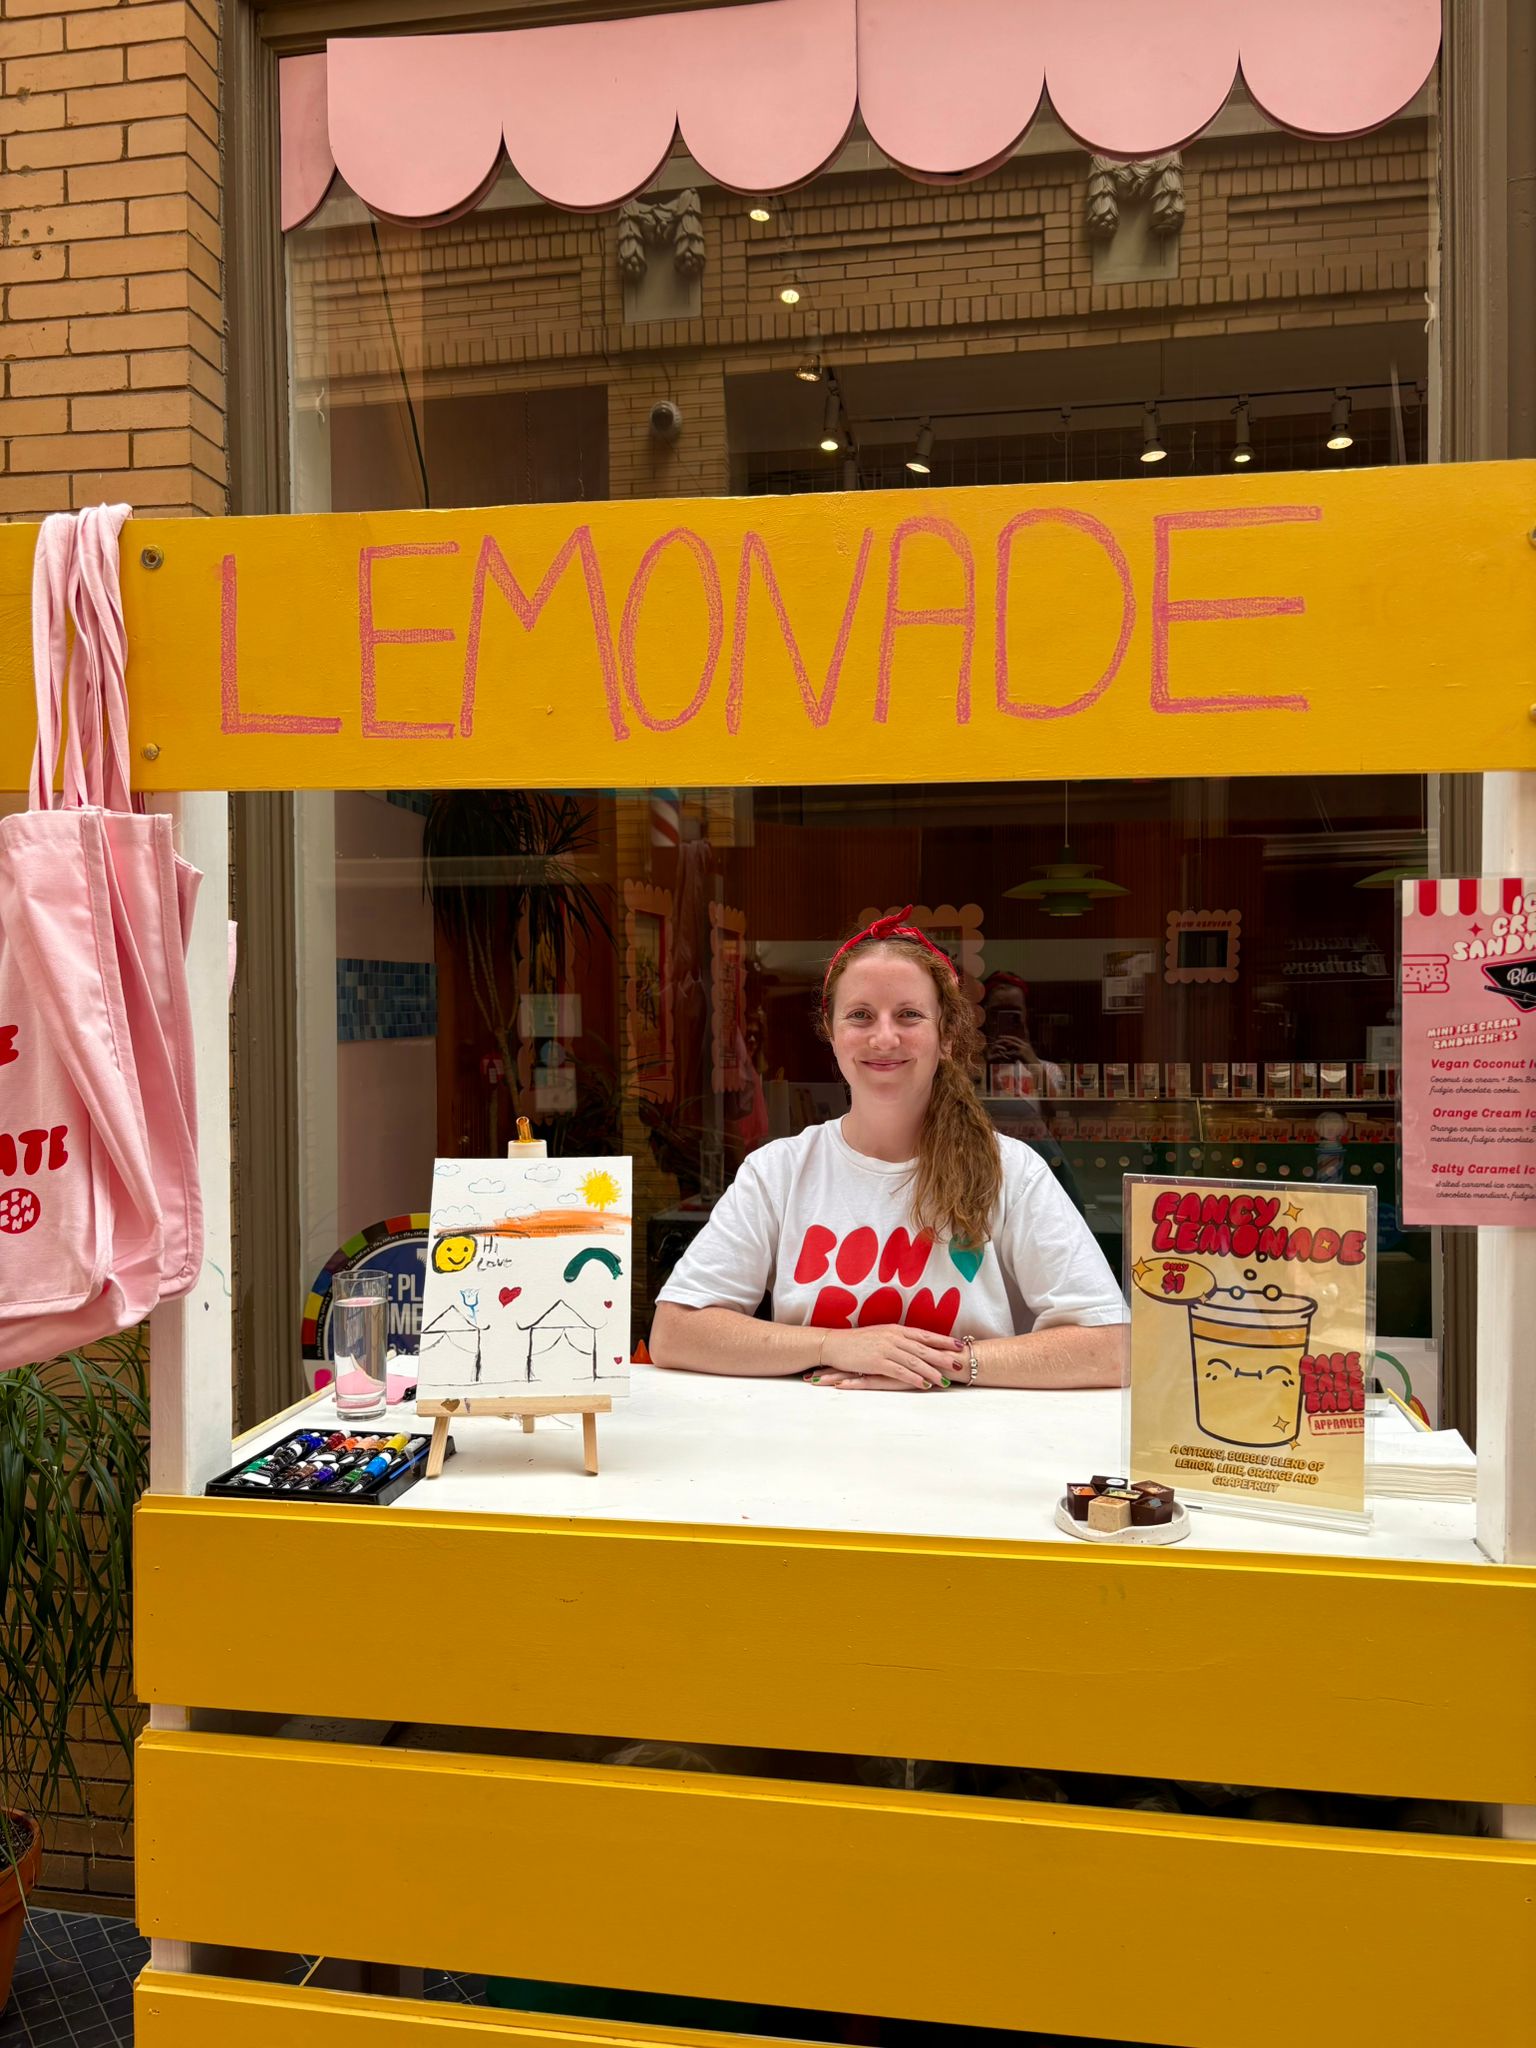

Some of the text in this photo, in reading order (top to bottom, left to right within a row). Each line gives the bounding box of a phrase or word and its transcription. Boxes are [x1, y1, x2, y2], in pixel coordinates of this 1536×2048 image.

[221, 506, 1321, 740] LEMONADE
[1427, 1018, 1521, 1039] MINI ICE CREAM
[1433, 1030, 1518, 1049] SANDWICH: $6
[1431, 1058, 1470, 1071] Vegan
[1473, 1058, 1526, 1069] Coconut
[1455, 1086, 1492, 1094] chocolate
[1433, 1107, 1478, 1120] Orange
[1482, 1108, 1522, 1118] Cream
[1430, 1125, 1458, 1134] Orange
[1431, 1163, 1464, 1176] Salty
[1468, 1164, 1521, 1174] Caramel
[1436, 1190, 1472, 1198] chocolate
[1151, 1191, 1281, 1229] FANCY
[1151, 1220, 1367, 1265] LEMONADE
[793, 1224, 936, 1288] BON
[1162, 1261, 1190, 1272] ONLY
[1161, 1270, 1185, 1295] $1
[1170, 1444, 1325, 1472] A CITRUSY, BUBBLY BLEND OF
[1175, 1458, 1320, 1485] LEMON, LIME, ORANGE AND
[1212, 1476, 1281, 1494] GRAPEFRUIT
